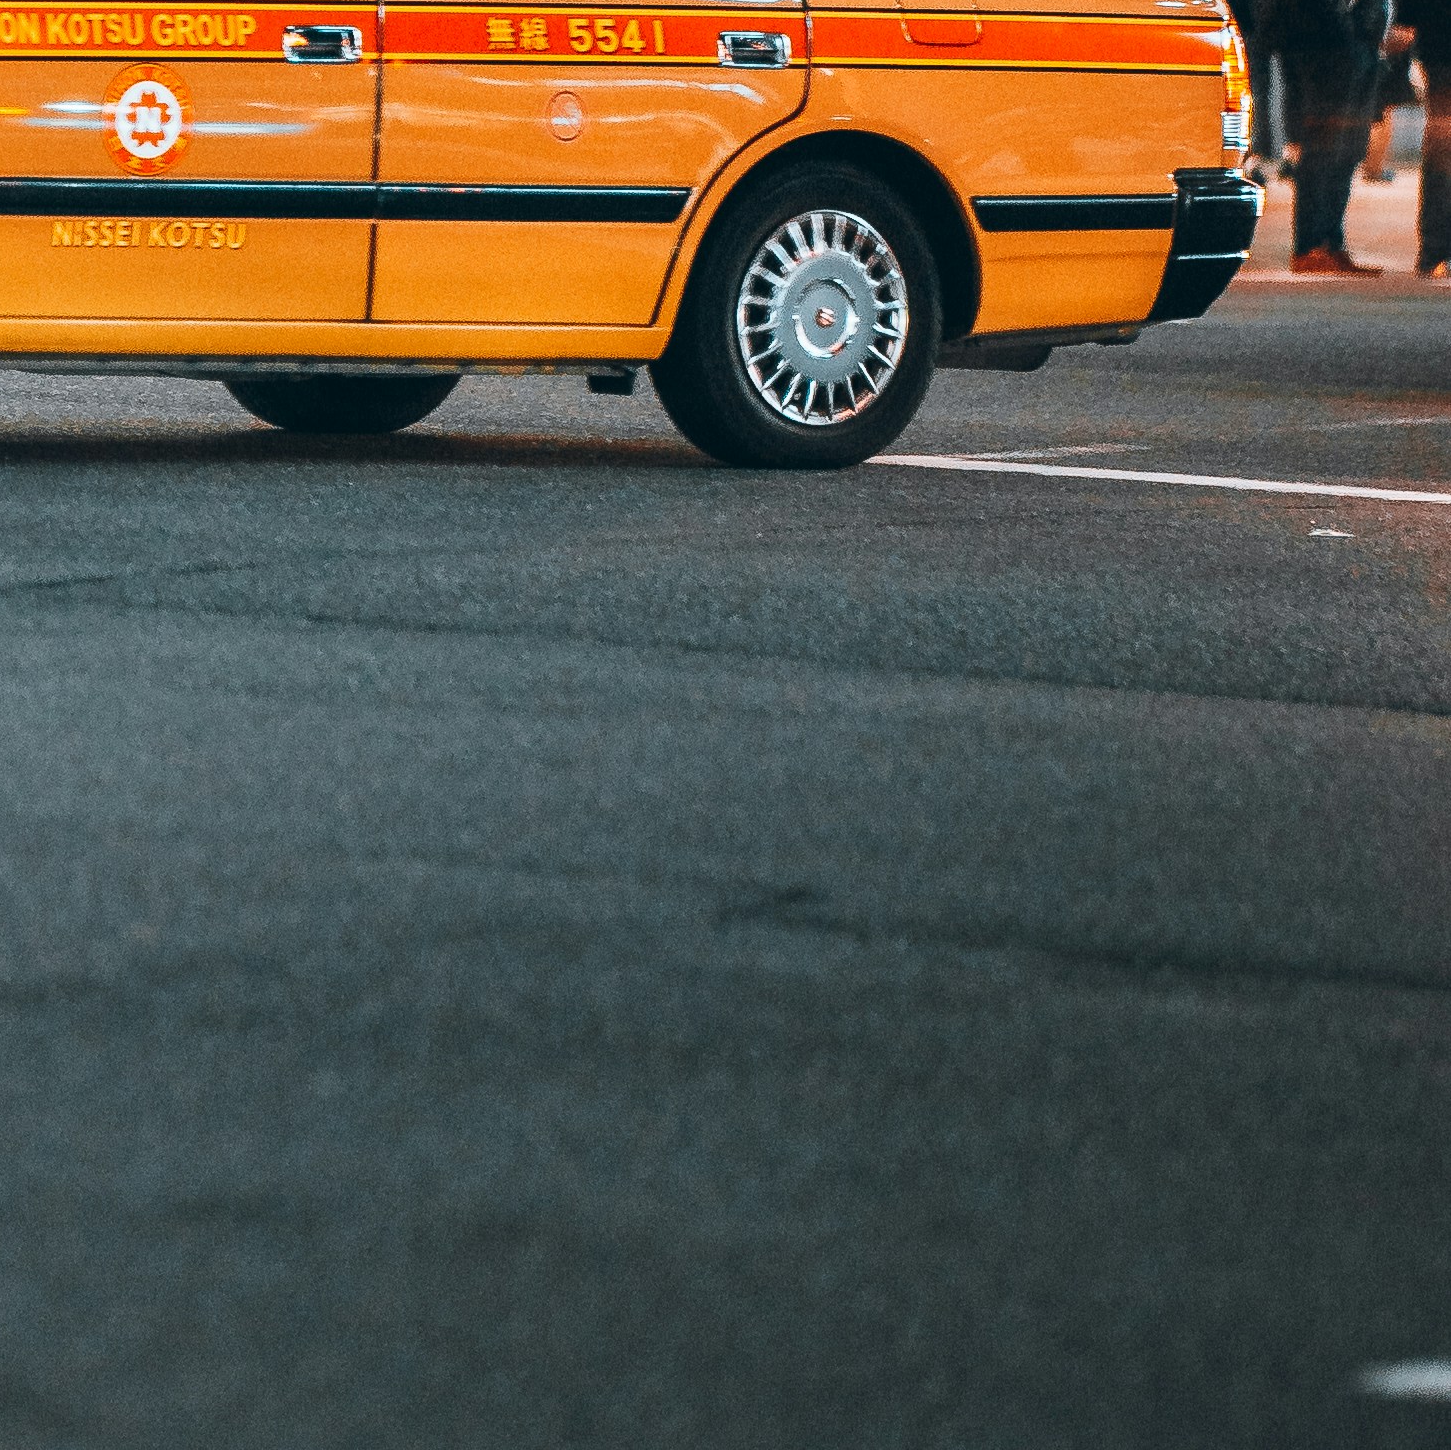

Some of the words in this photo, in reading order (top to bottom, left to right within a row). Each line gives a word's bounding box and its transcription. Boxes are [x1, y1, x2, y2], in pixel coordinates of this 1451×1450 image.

[47, 12, 145, 47] KOTSU
[151, 13, 257, 47] GROUP
[567, 17, 667, 54] 5541
[51, 219, 139, 248] NISSEI
[148, 221, 247, 251] KOTSU
